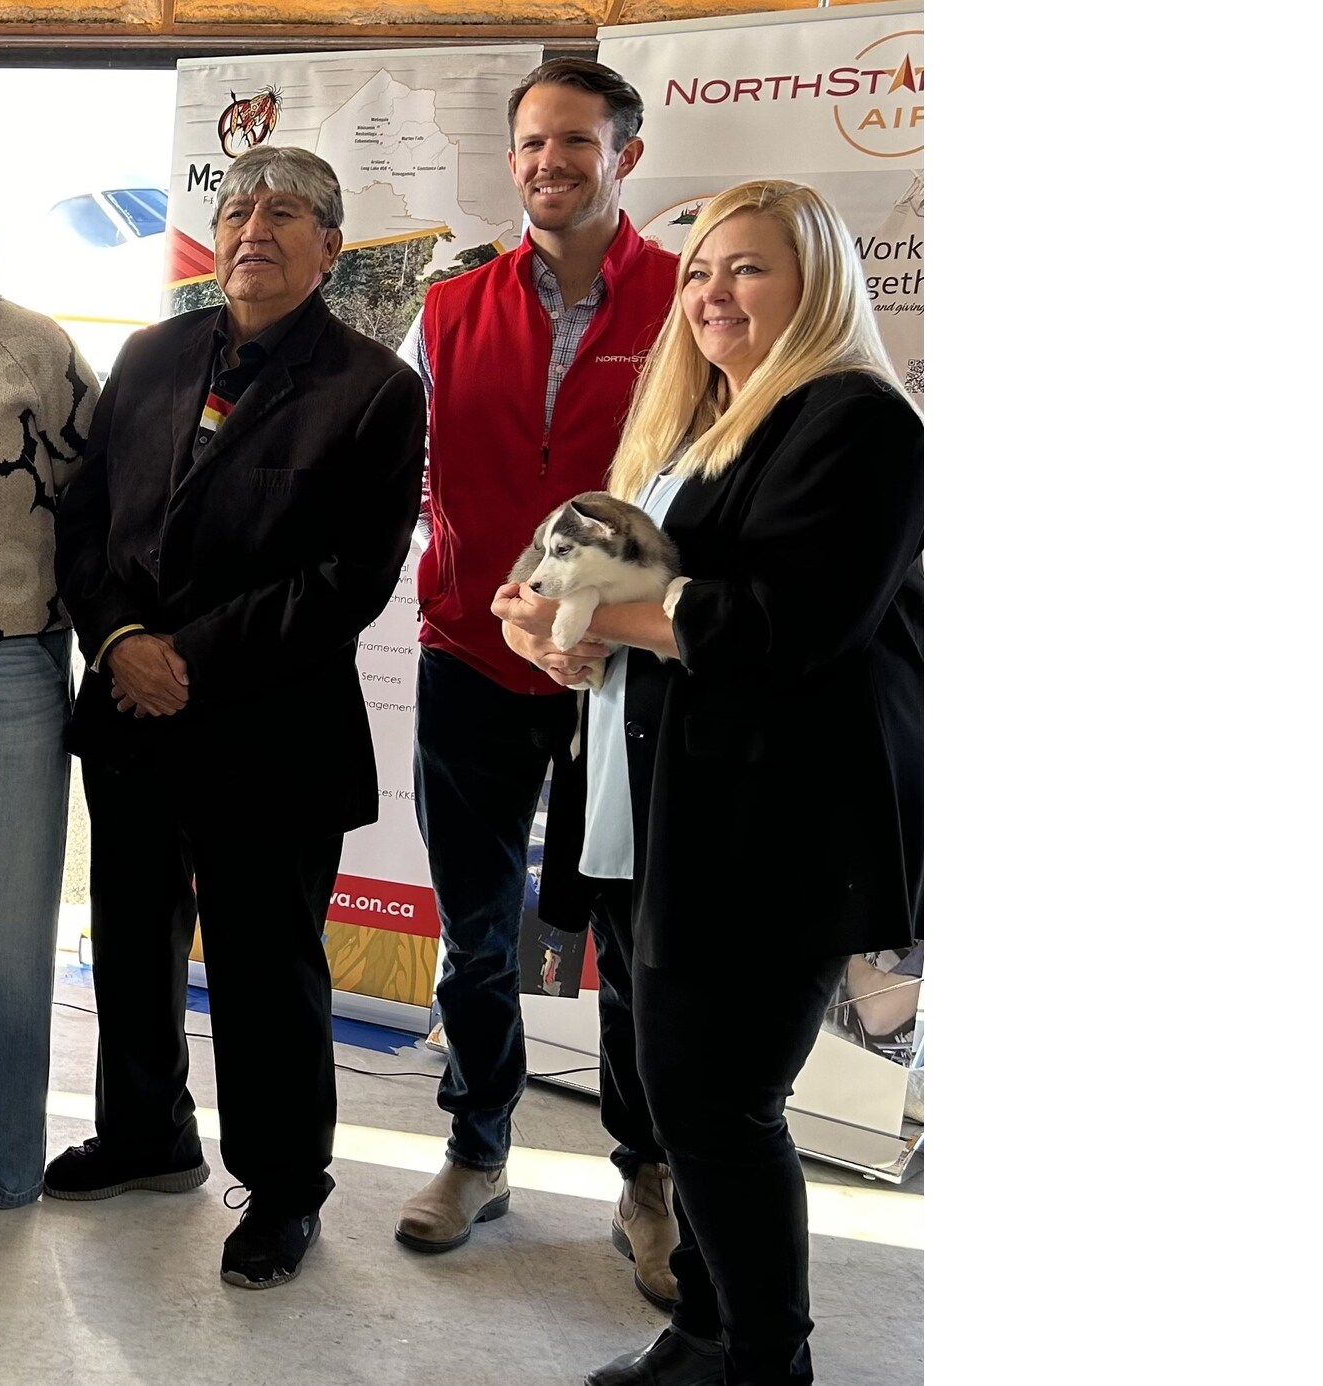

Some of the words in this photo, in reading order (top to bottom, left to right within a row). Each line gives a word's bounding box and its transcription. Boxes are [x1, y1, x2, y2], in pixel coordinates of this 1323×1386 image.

[665, 53, 924, 106] NORTHSTA
[874, 302, 896, 311] and
[595, 355, 646, 363] NORTHST
[359, 641, 413, 655] Framework
[361, 672, 401, 684] Services
[329, 892, 414, 918] a.on.ca
